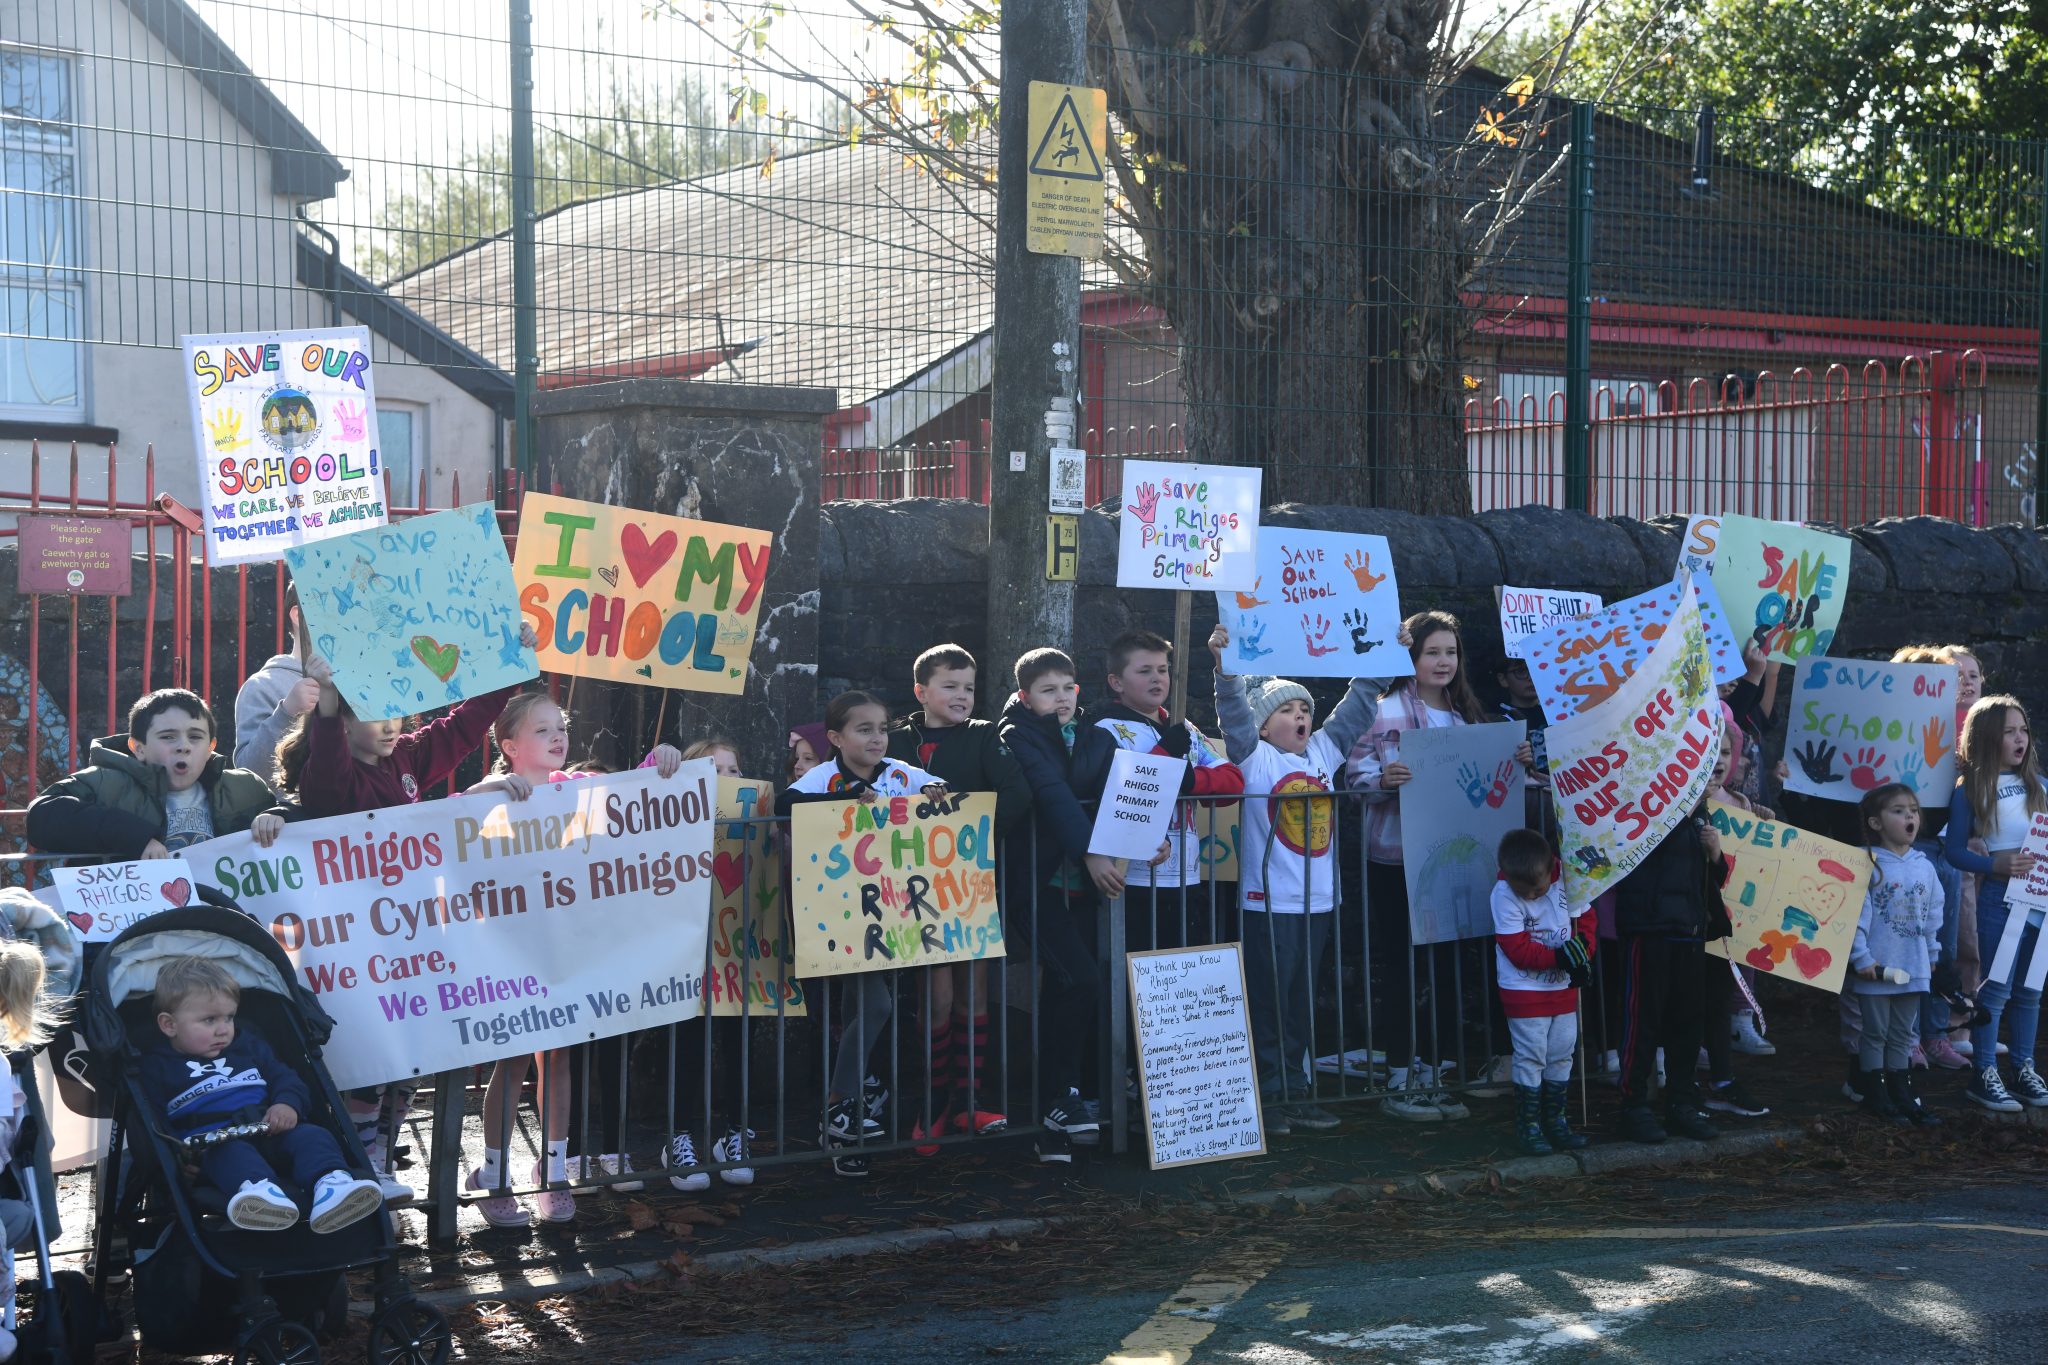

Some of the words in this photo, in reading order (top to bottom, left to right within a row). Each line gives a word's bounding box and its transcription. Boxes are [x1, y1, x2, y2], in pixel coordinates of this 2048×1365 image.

[1042, 192, 1063, 200] DANGER
[1032, 202, 1057, 210] ELECTRIC
[1059, 205, 1087, 213] OVERHEAD
[194, 344, 280, 396] SAVE
[302, 344, 370, 390] OUR
[261, 382, 312, 400] RHIGOS
[257, 428, 293, 454] PRIMARY
[301, 423, 324, 450] SCHOOL
[219, 449, 379, 495] SCHOOL!
[212, 503, 235, 520] WE
[239, 498, 284, 518] CARE,
[285, 495, 304, 508] WE
[50, 524, 78, 532] Please
[80, 525, 102, 533] close
[213, 516, 299, 542] TOGETHER
[302, 512, 322, 528] WE
[1175, 505, 1239, 538] Rhigos
[75, 536, 94, 545] gate
[1064, 528, 1073, 538] 75
[1141, 524, 1223, 562] Primary
[42, 549, 75, 557] Caewch
[85, 551, 97, 559] gat
[534, 511, 596, 580] I
[1281, 545, 1325, 566] SAVE
[41, 560, 79, 569] gwelwch
[94, 561, 110, 569] dda
[1065, 559, 1070, 568] 3
[1758, 541, 1837, 600] SAVE
[1282, 582, 1336, 603] SCHOOL
[1548, 597, 1581, 617] SHUT
[1755, 592, 1820, 631] OUR
[520, 582, 726, 672] SCHOOL
[1509, 615, 1537, 634] THE
[1555, 624, 1631, 664] SAVE
[1803, 661, 1894, 694] Save
[1802, 701, 1915, 745] School
[1553, 741, 1629, 798] HANDS
[1634, 687, 1675, 738] OFF
[1134, 765, 1158, 777] SAVE
[1124, 779, 1160, 793] RHIGOS
[1116, 794, 1159, 808] PRIMARY
[838, 797, 909, 840] SAVE
[1114, 810, 1151, 824] SCHOOL
[1710, 807, 1776, 848] AVE
[214, 854, 304, 902] Save
[312, 830, 443, 886] Rhigos
[454, 807, 595, 862] Primary
[606, 777, 710, 839] School
[1617, 832, 1663, 874] RHIGOS
[1663, 816, 1677, 831] IS
[1675, 784, 1702, 815] THE
[824, 815, 994, 880] SCHOOL
[77, 864, 140, 884] SAVE
[77, 882, 153, 909] RHIGOS
[272, 911, 355, 951] Our
[370, 879, 527, 940] Cynefin
[542, 870, 576, 909] is
[588, 850, 714, 900] Rhigos
[305, 962, 357, 995] We
[368, 950, 457, 984] Care,
[1133, 962, 1149, 983] You
[1154, 960, 1177, 972] think
[1180, 961, 1196, 977] you
[378, 991, 428, 1023] We
[438, 974, 548, 1012] Believe,
[452, 1003, 579, 1046] Together
[586, 989, 631, 1019] We
[1139, 1006, 1151, 1017] You
[1156, 1004, 1177, 1016] think
[1182, 1004, 1194, 1017] you
[1141, 1018, 1154, 1028] But
[1213, 1008, 1234, 1017] means
[1226, 1045, 1245, 1054] home
[1170, 1064, 1200, 1076] teachers
[170, 1082, 214, 1110] UNDER
[1148, 1081, 1174, 1092] dreams
[1195, 1082, 1211, 1096] goes
[1226, 1077, 1246, 1086] alone
[1165, 1105, 1184, 1116] belong
[1187, 1102, 1198, 1112] and
[1219, 1106, 1236, 1120] proud
[1153, 1131, 1165, 1140] The
[1190, 1124, 1204, 1134] that
[1216, 1119, 1229, 1128] have
[1232, 1118, 1240, 1126] for
[1240, 1130, 1259, 1146] LOUD
